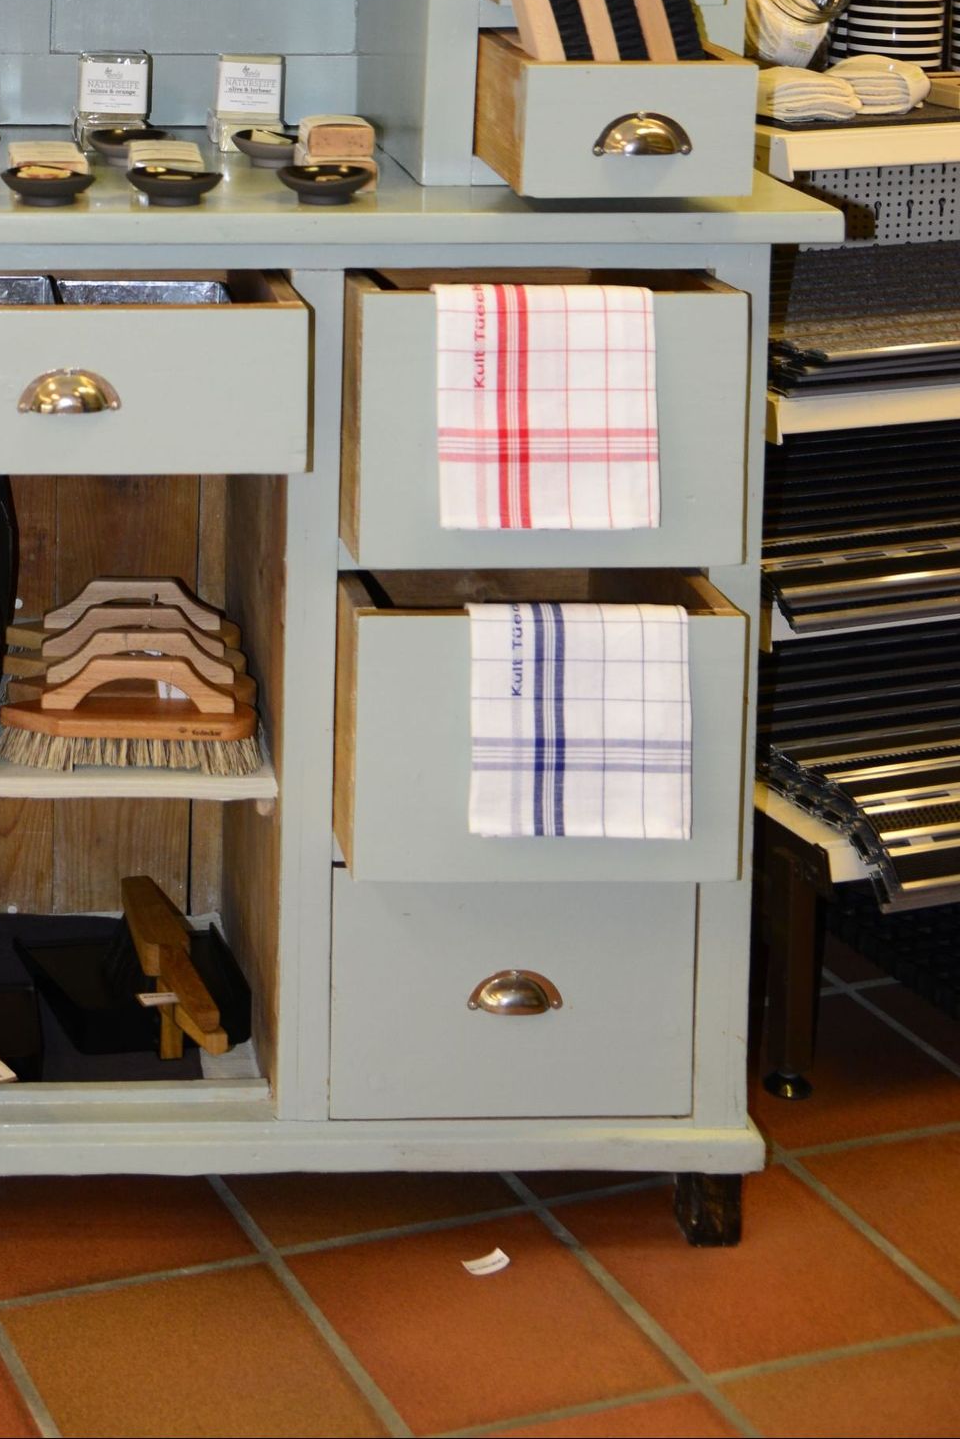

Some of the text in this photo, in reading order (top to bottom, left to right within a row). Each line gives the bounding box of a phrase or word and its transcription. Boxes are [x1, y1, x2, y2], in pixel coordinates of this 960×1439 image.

[88, 80, 140, 89] NATURSEIFE
[225, 79, 276, 88] NATURSEIFE
[474, 351, 486, 388] Kult
[511, 659, 522, 696] Kult
